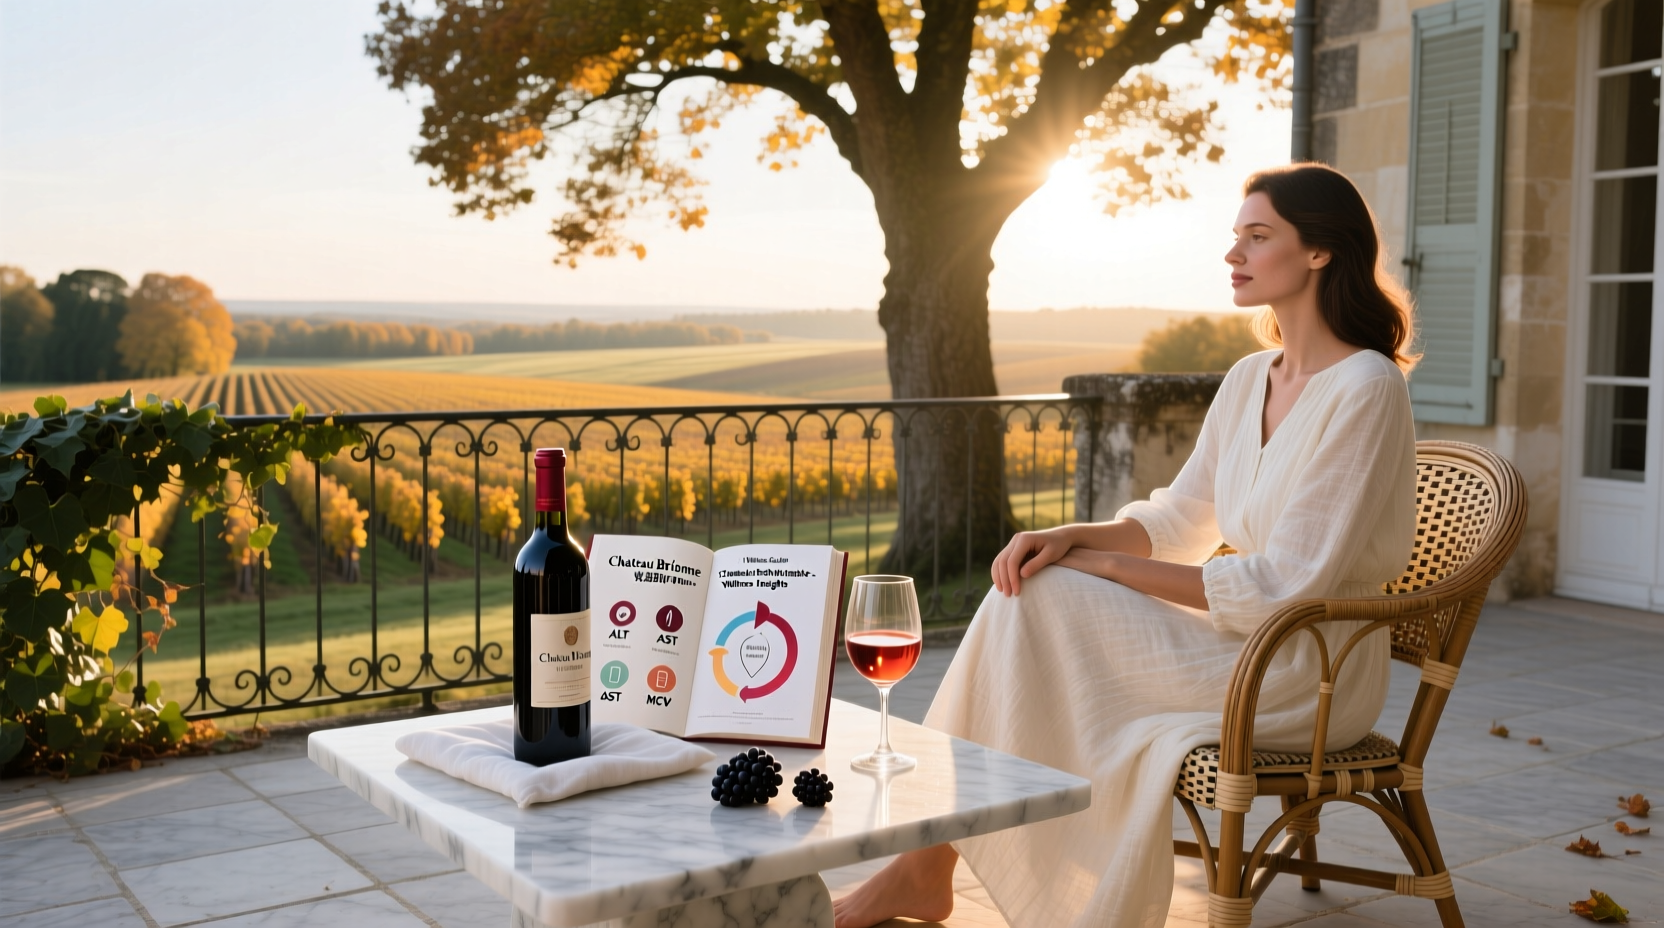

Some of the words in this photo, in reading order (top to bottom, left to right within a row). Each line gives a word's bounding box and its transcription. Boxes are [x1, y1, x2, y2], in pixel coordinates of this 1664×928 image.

[608, 629, 630, 640] ALT
[656, 634, 678, 646] AST
[646, 694, 672, 707] MCV
